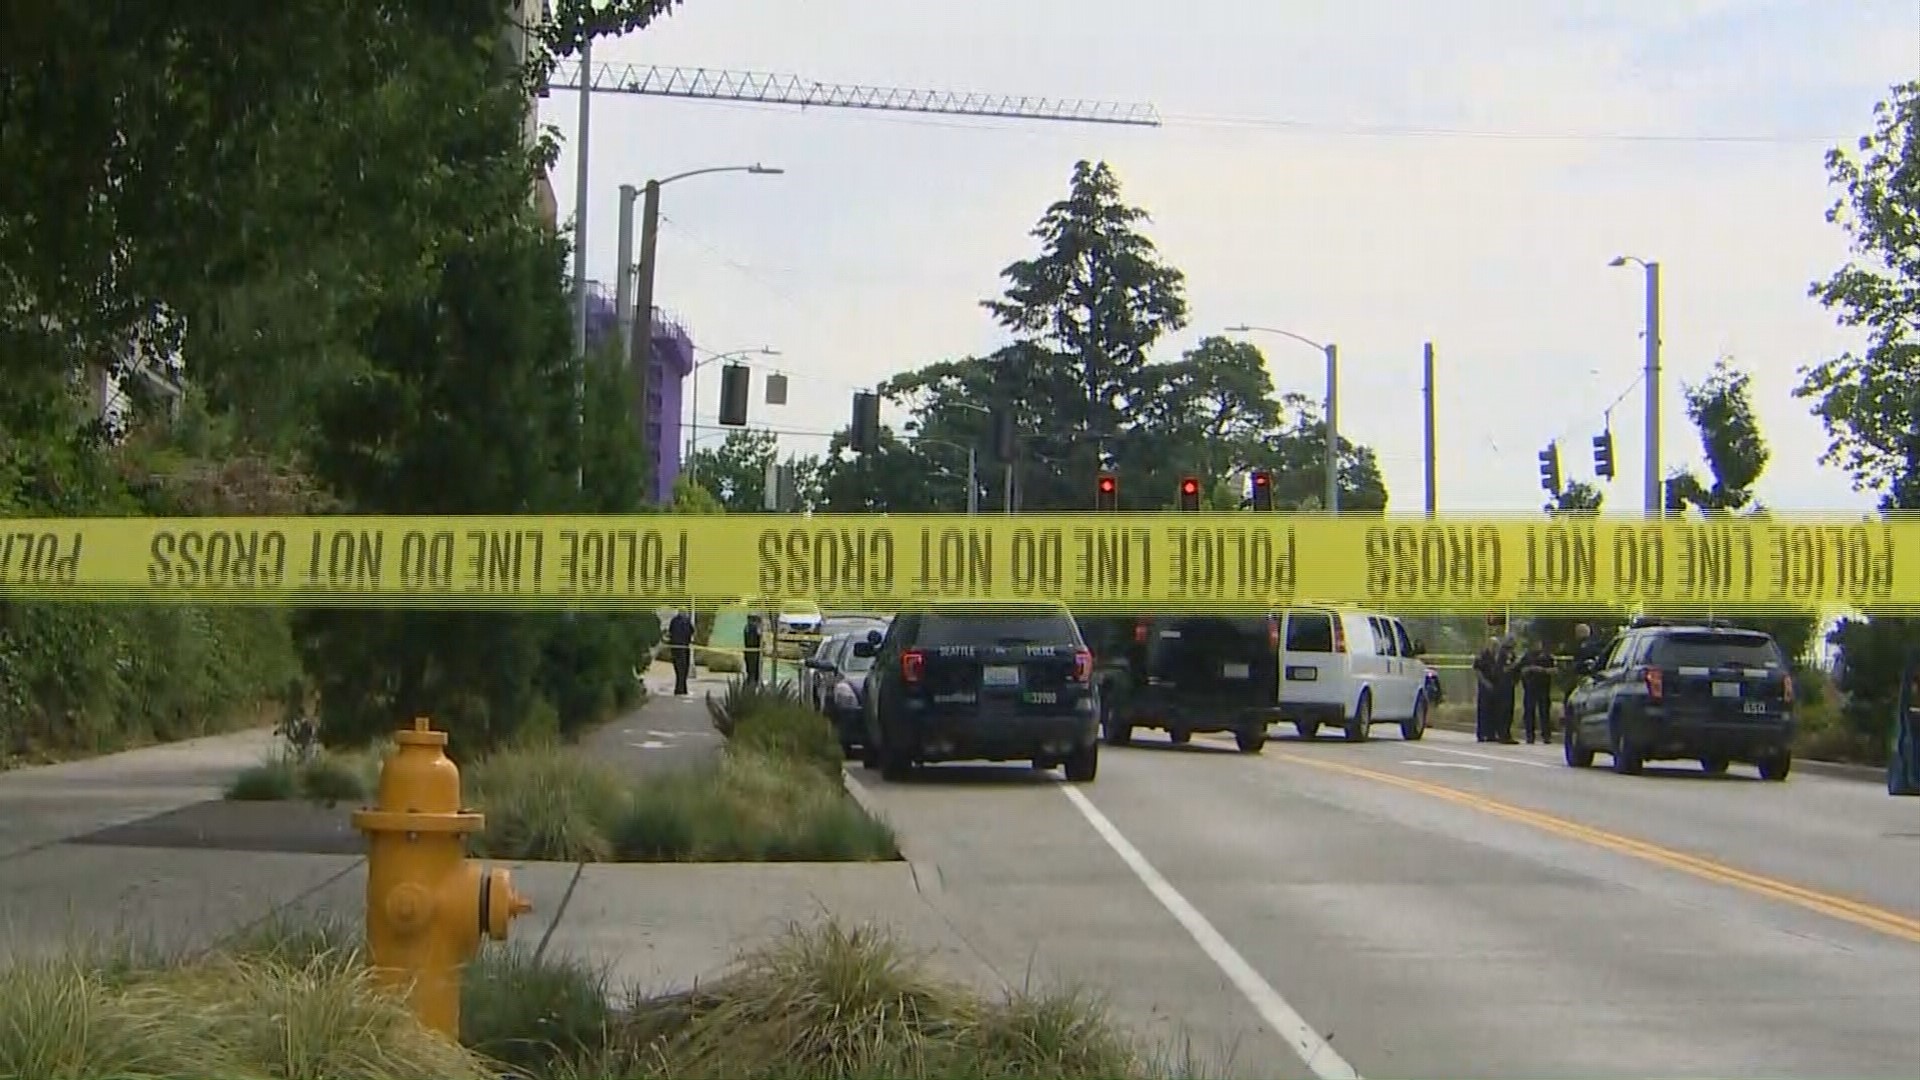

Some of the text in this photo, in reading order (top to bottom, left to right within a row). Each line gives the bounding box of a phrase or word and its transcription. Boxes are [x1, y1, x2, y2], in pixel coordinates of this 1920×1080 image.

[0, 532, 83, 585] POLI
[147, 529, 688, 594] POLICE LINE DO NOT CROSS
[758, 527, 1297, 597] POLICE LINE DO NOT CROSS
[1365, 525, 1895, 599] POLICE LINE DO NOT CROSS
[939, 645, 1057, 657] SEATTLE POLICE
